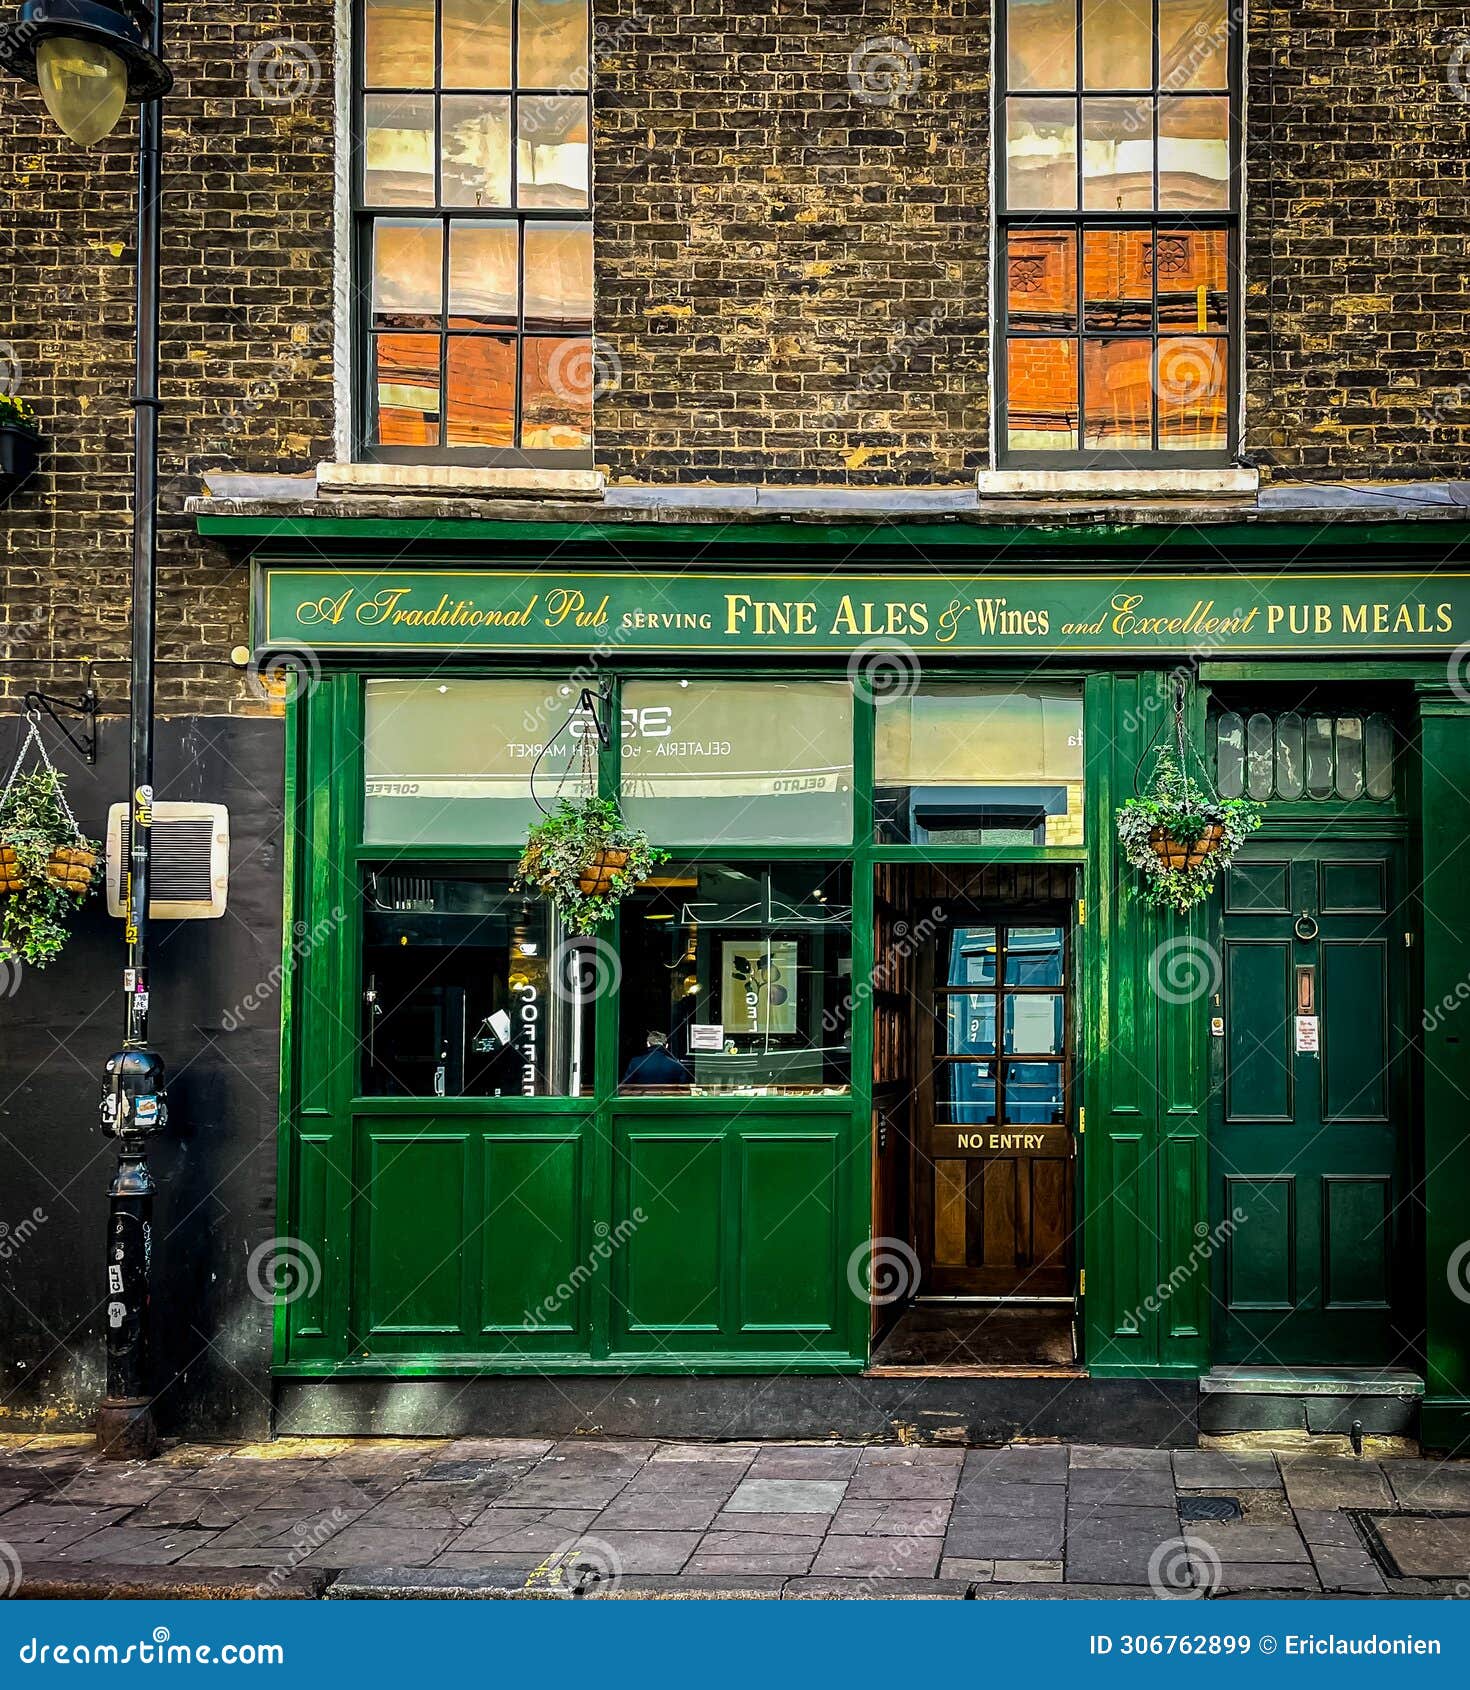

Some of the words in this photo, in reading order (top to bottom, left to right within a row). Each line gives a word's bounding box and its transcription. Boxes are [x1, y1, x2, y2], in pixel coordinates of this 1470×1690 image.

[296, 588, 355, 625] A
[355, 588, 539, 627] Traditional
[545, 588, 610, 628] Pub
[621, 612, 713, 630] SERVING
[724, 594, 818, 635] FINE
[829, 594, 929, 636] ALES
[935, 599, 972, 643] &
[974, 597, 1050, 636] Wines
[1061, 612, 1108, 635] and
[1111, 593, 1260, 639] Excellent
[1267, 604, 1333, 634] PUB
[1342, 603, 1453, 634] MEALS
[957, 1133, 984, 1149] NO
[989, 1133, 1045, 1149] ENTRY
